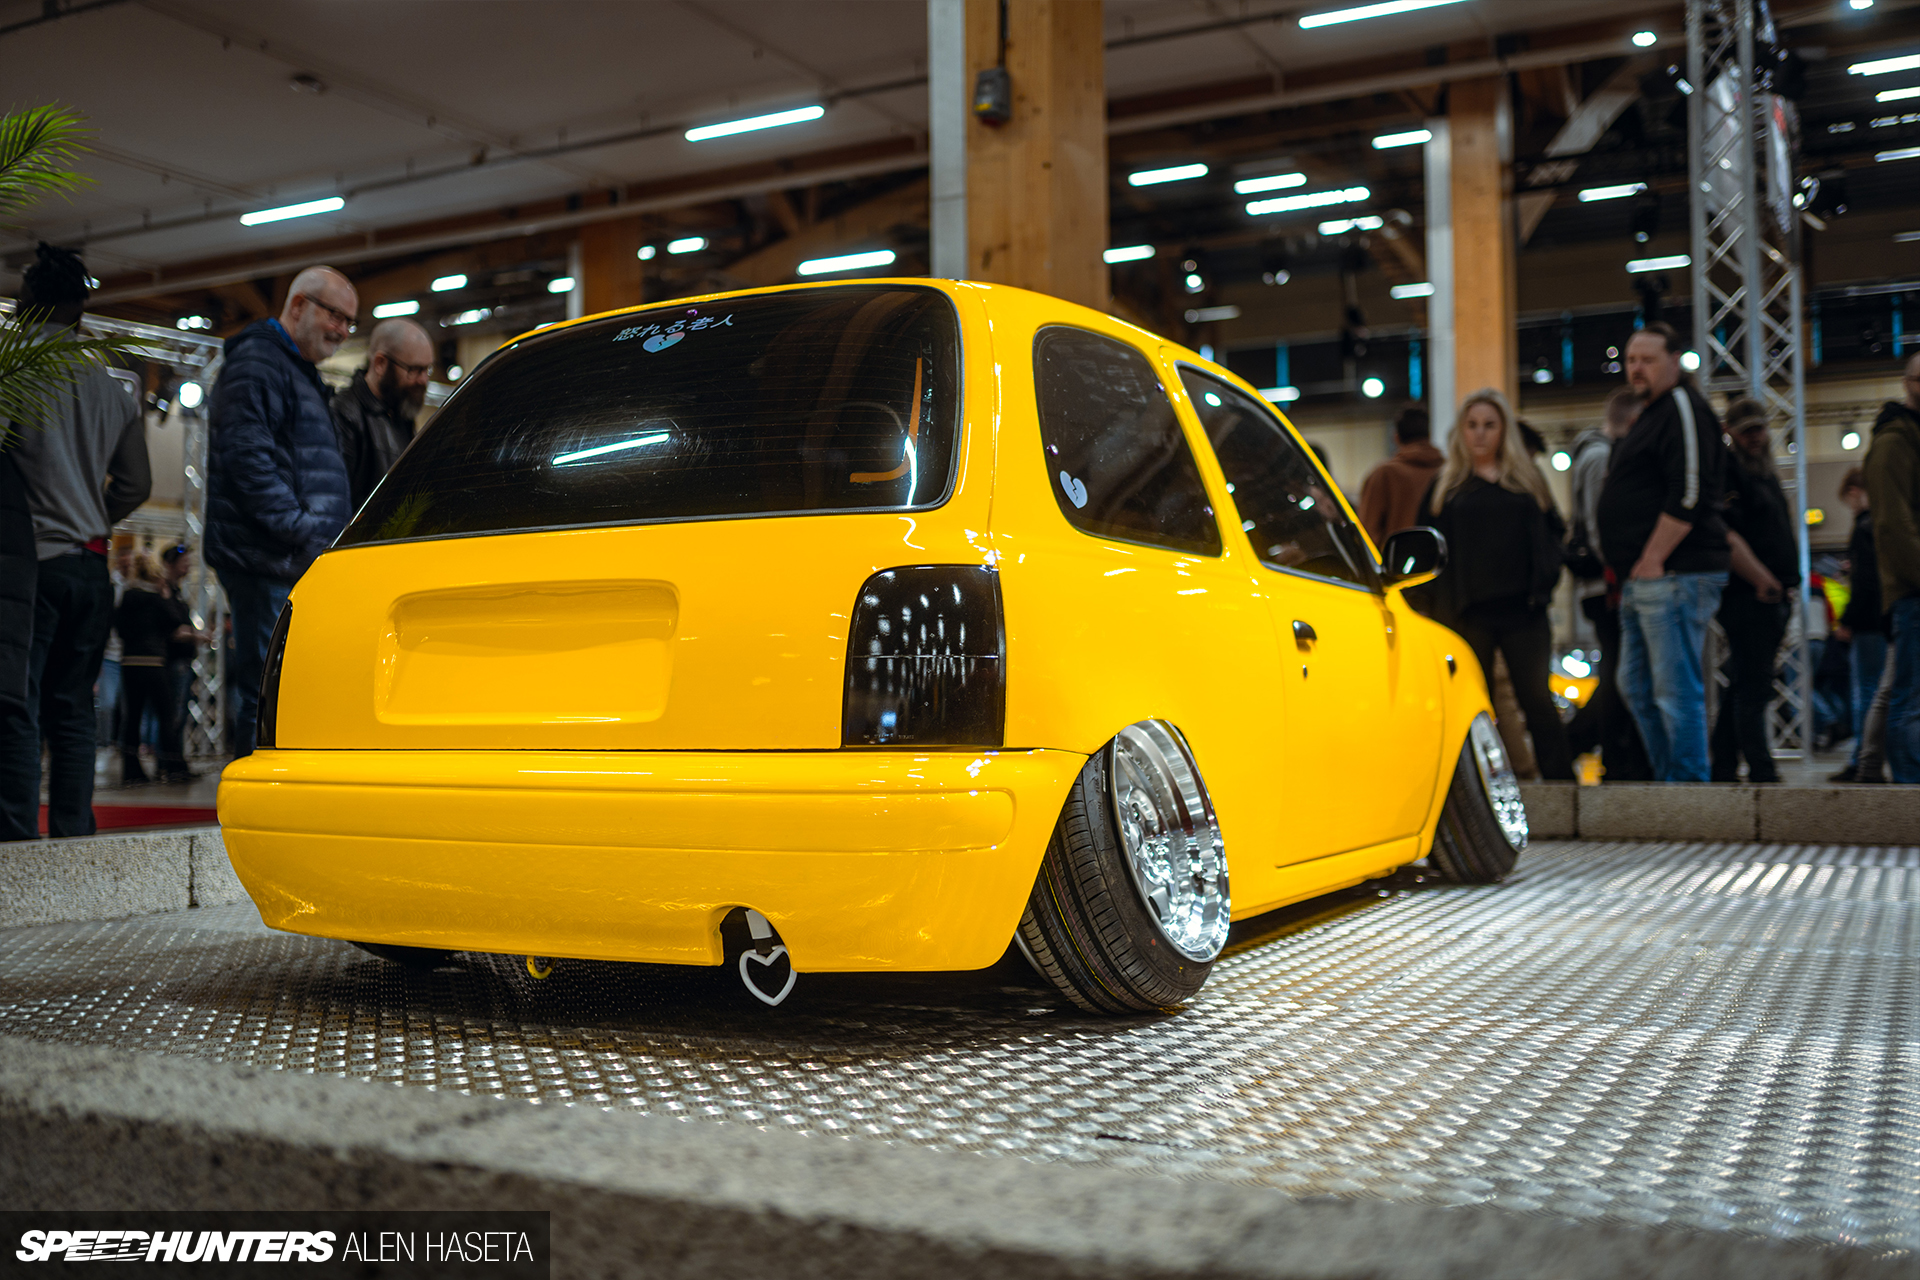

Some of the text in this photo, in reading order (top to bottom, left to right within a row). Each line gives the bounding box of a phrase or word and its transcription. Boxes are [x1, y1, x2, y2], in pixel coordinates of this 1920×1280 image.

[612, 314, 733, 342] 怒れる老人
